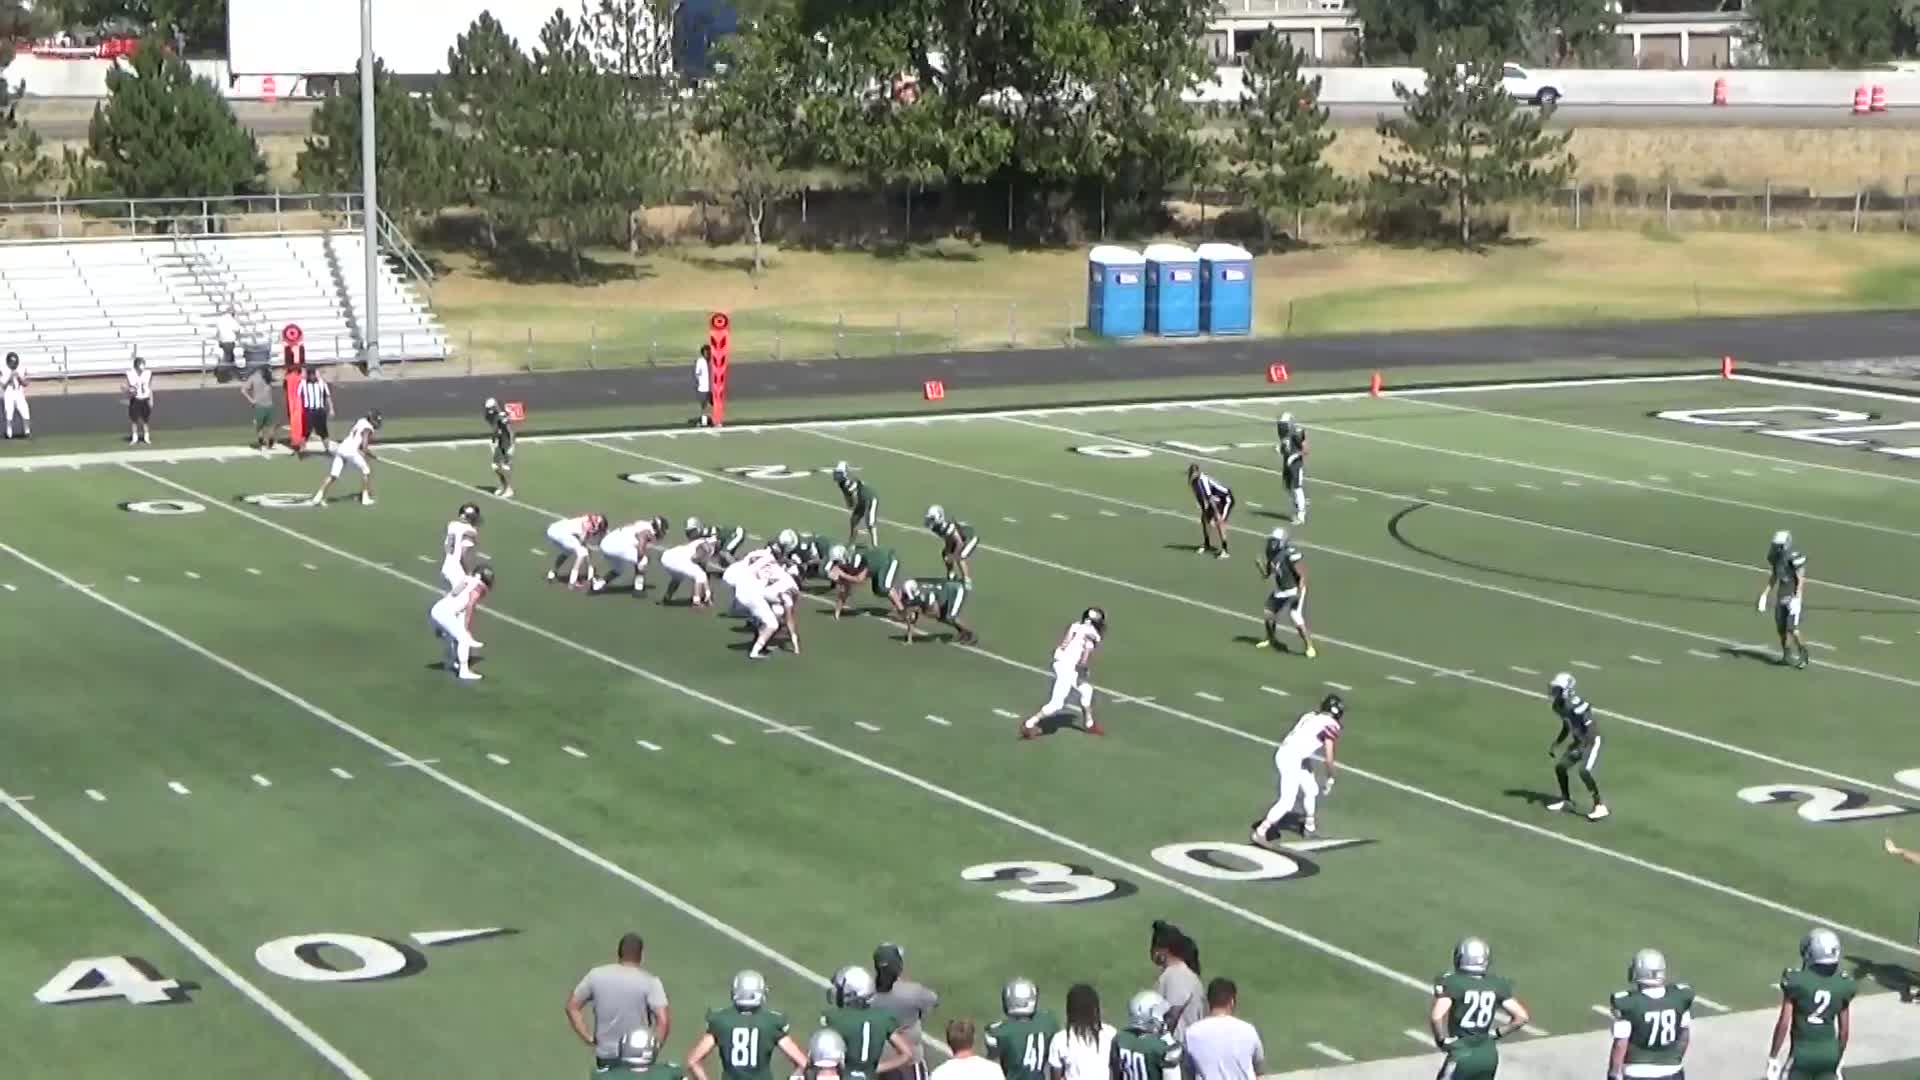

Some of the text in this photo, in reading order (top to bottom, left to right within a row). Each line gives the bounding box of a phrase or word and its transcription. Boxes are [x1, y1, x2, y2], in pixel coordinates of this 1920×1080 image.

[961, 841, 1321, 904] 30
[34, 931, 428, 1005] 40
[1459, 989, 1497, 1029] 28
[1644, 1008, 1677, 1047] 78
[1806, 989, 1833, 1025] 2
[730, 1026, 759, 1068] 81
[860, 1020, 871, 1063] 1
[1022, 1031, 1045, 1072] 41
